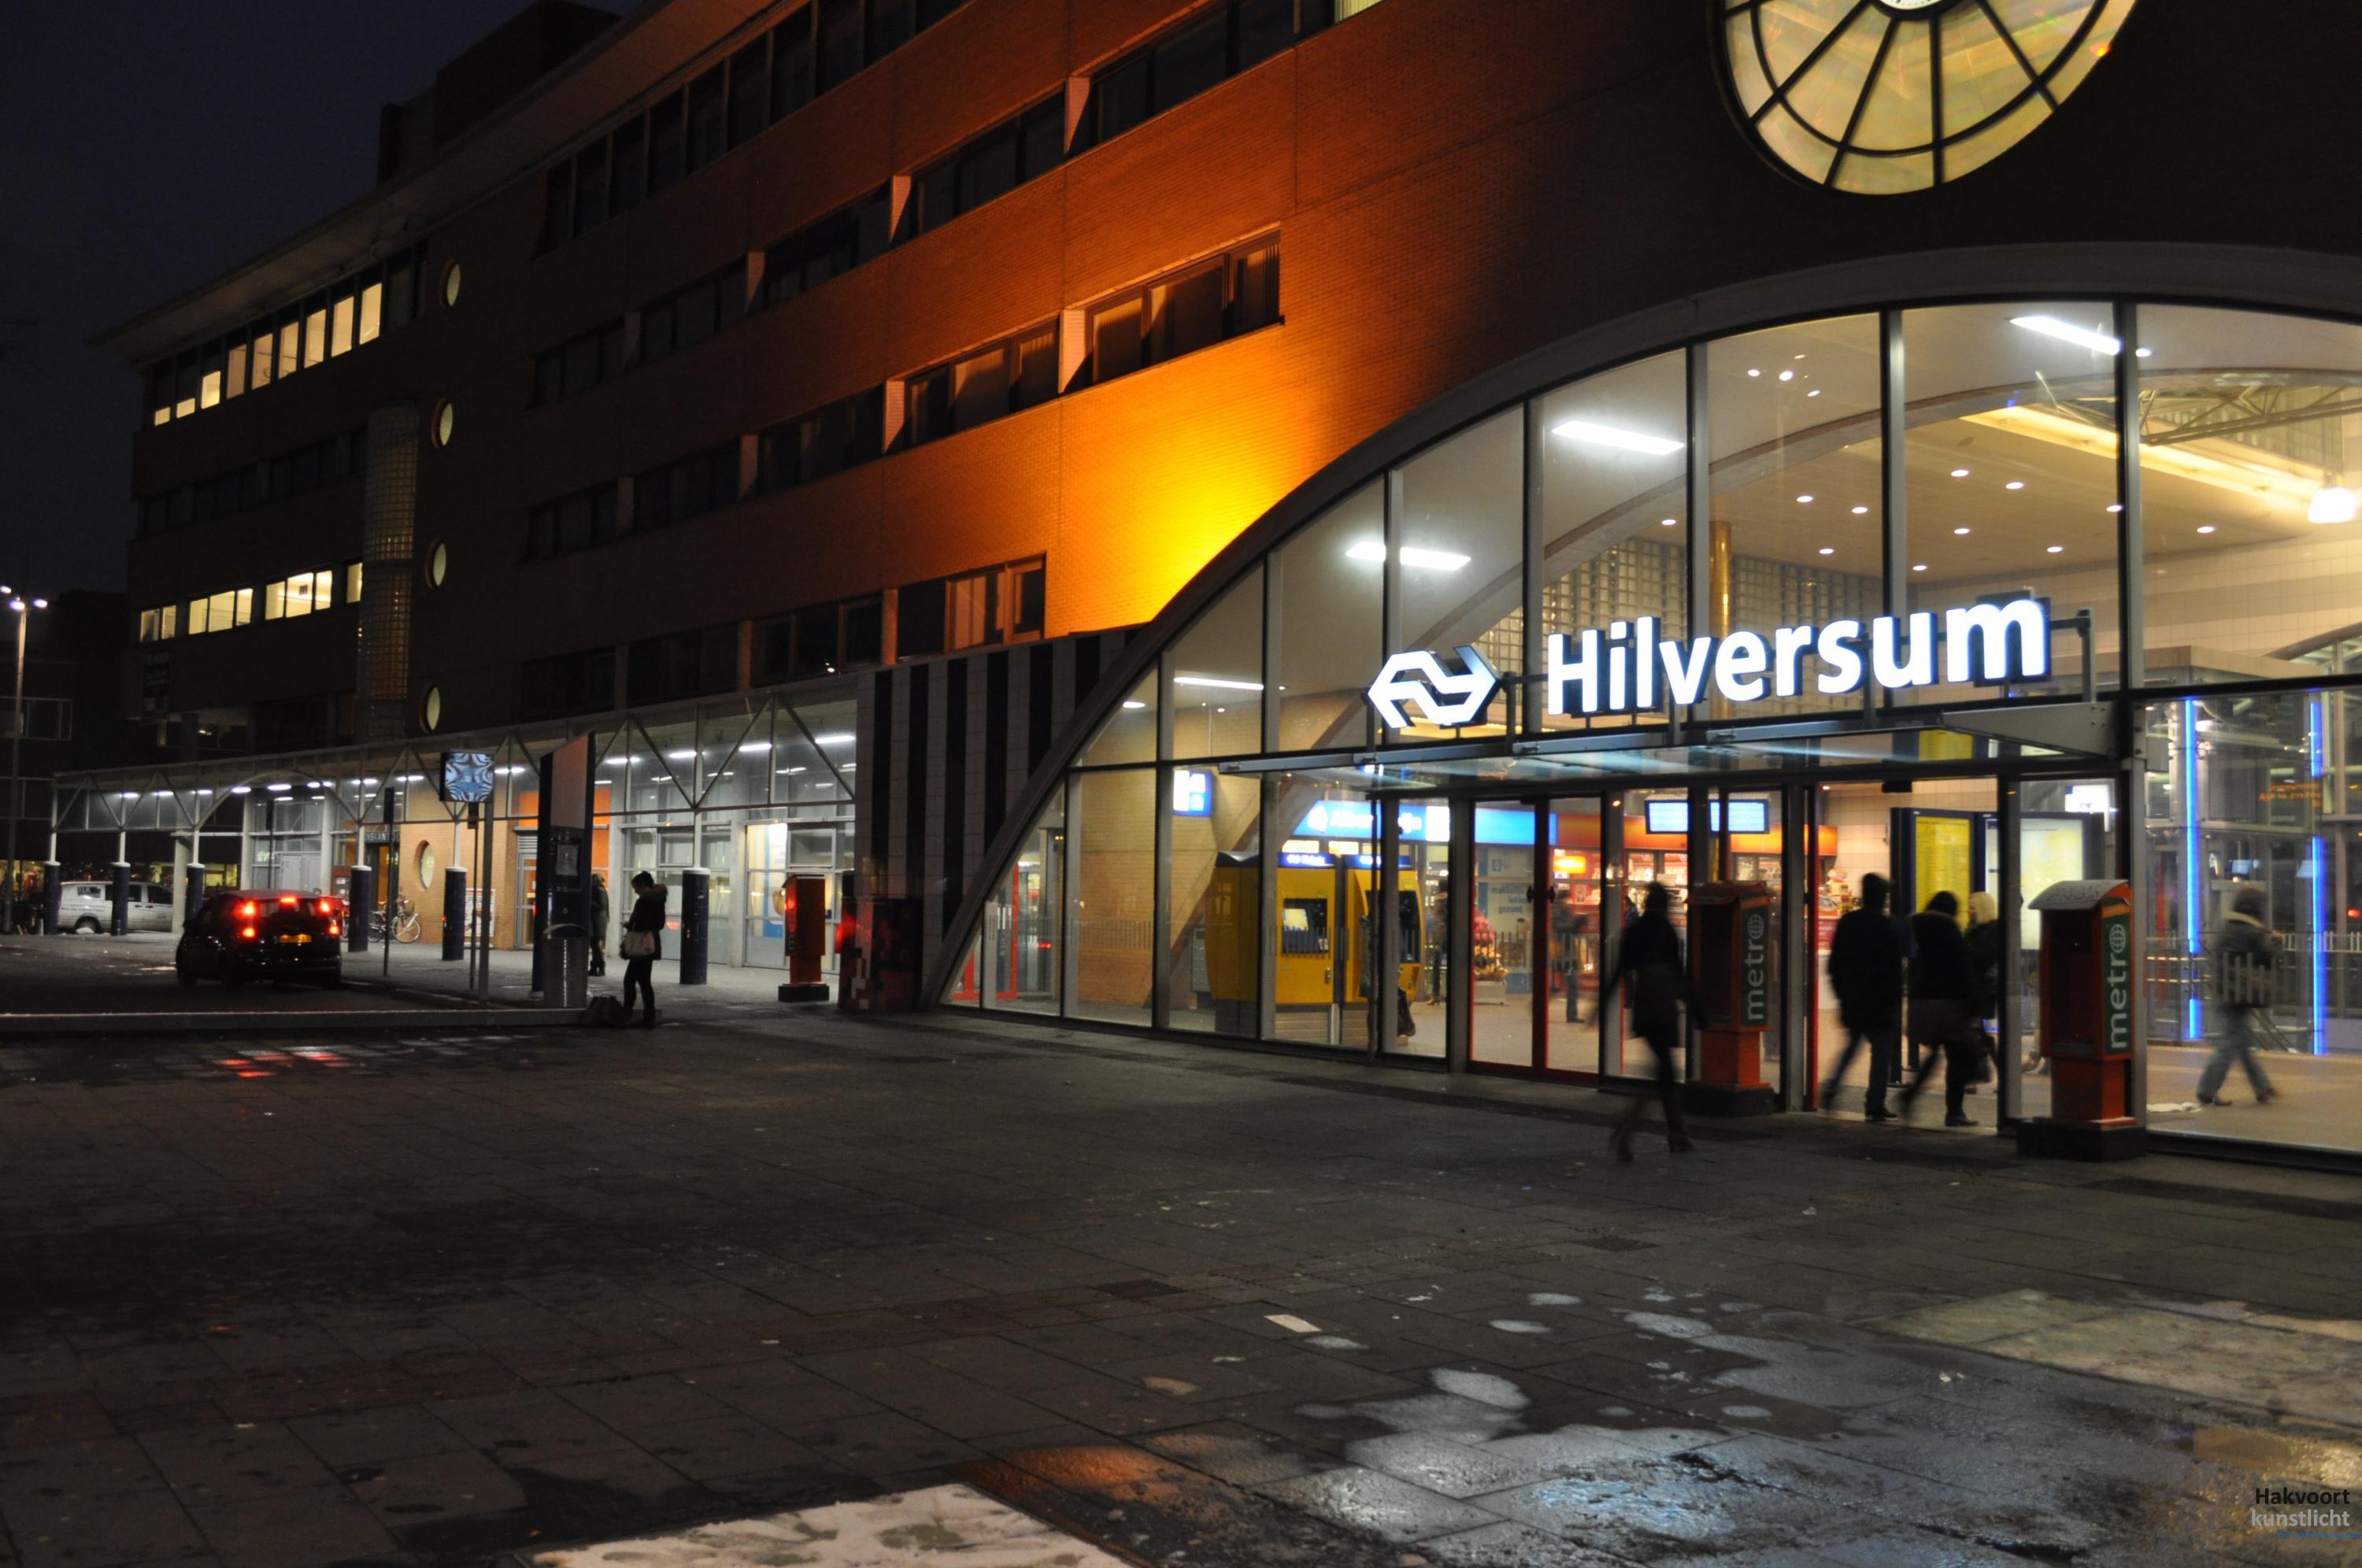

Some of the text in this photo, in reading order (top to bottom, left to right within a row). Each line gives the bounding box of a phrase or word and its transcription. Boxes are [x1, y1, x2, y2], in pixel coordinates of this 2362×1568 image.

[1548, 599, 2046, 715] Hilversum
[1745, 914, 1764, 1020] metro
[2107, 923, 2127, 1049] metro
